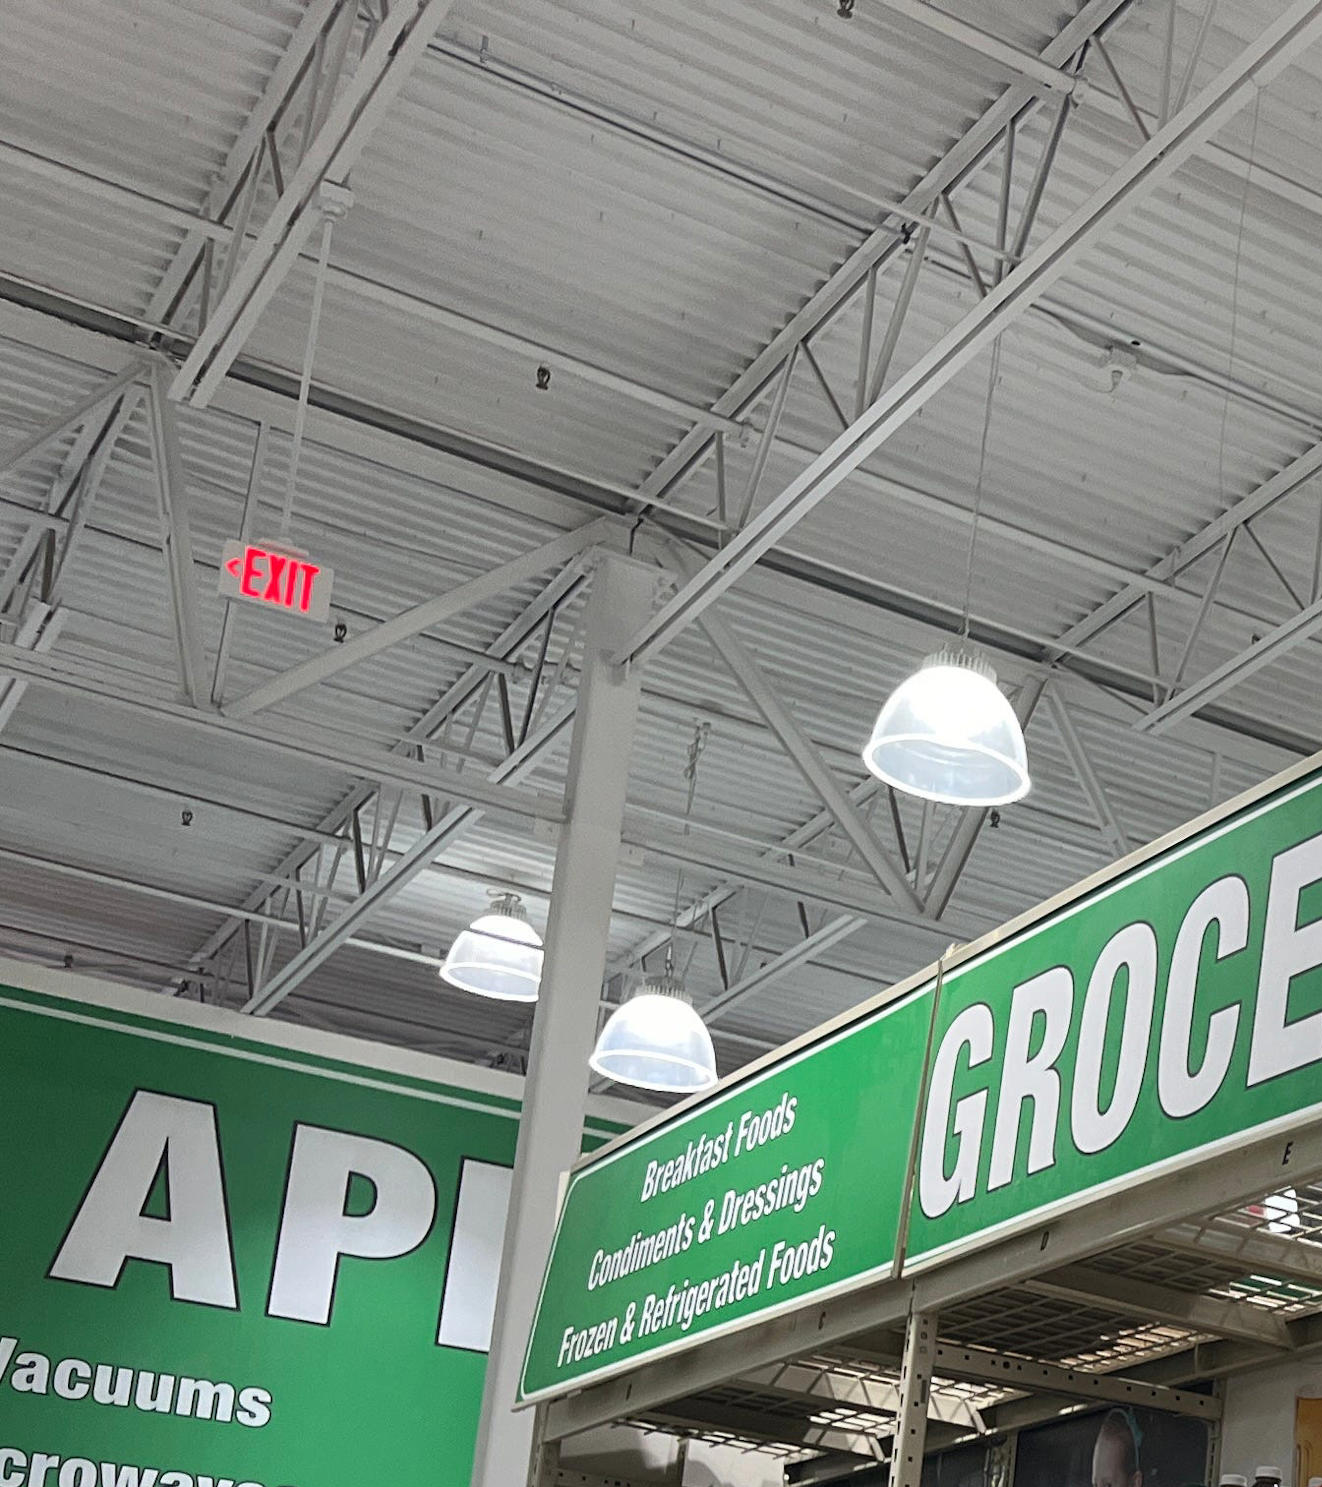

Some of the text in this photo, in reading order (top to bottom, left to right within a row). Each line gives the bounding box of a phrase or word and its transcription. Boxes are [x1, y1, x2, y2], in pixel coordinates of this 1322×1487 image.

[239, 545, 321, 614] EXIT
[641, 1093, 798, 1203] Breakfast Foods
[588, 1159, 824, 1291] Condiments & Dressings
[557, 1226, 836, 1367] Frozen & Refrigerated Foods
